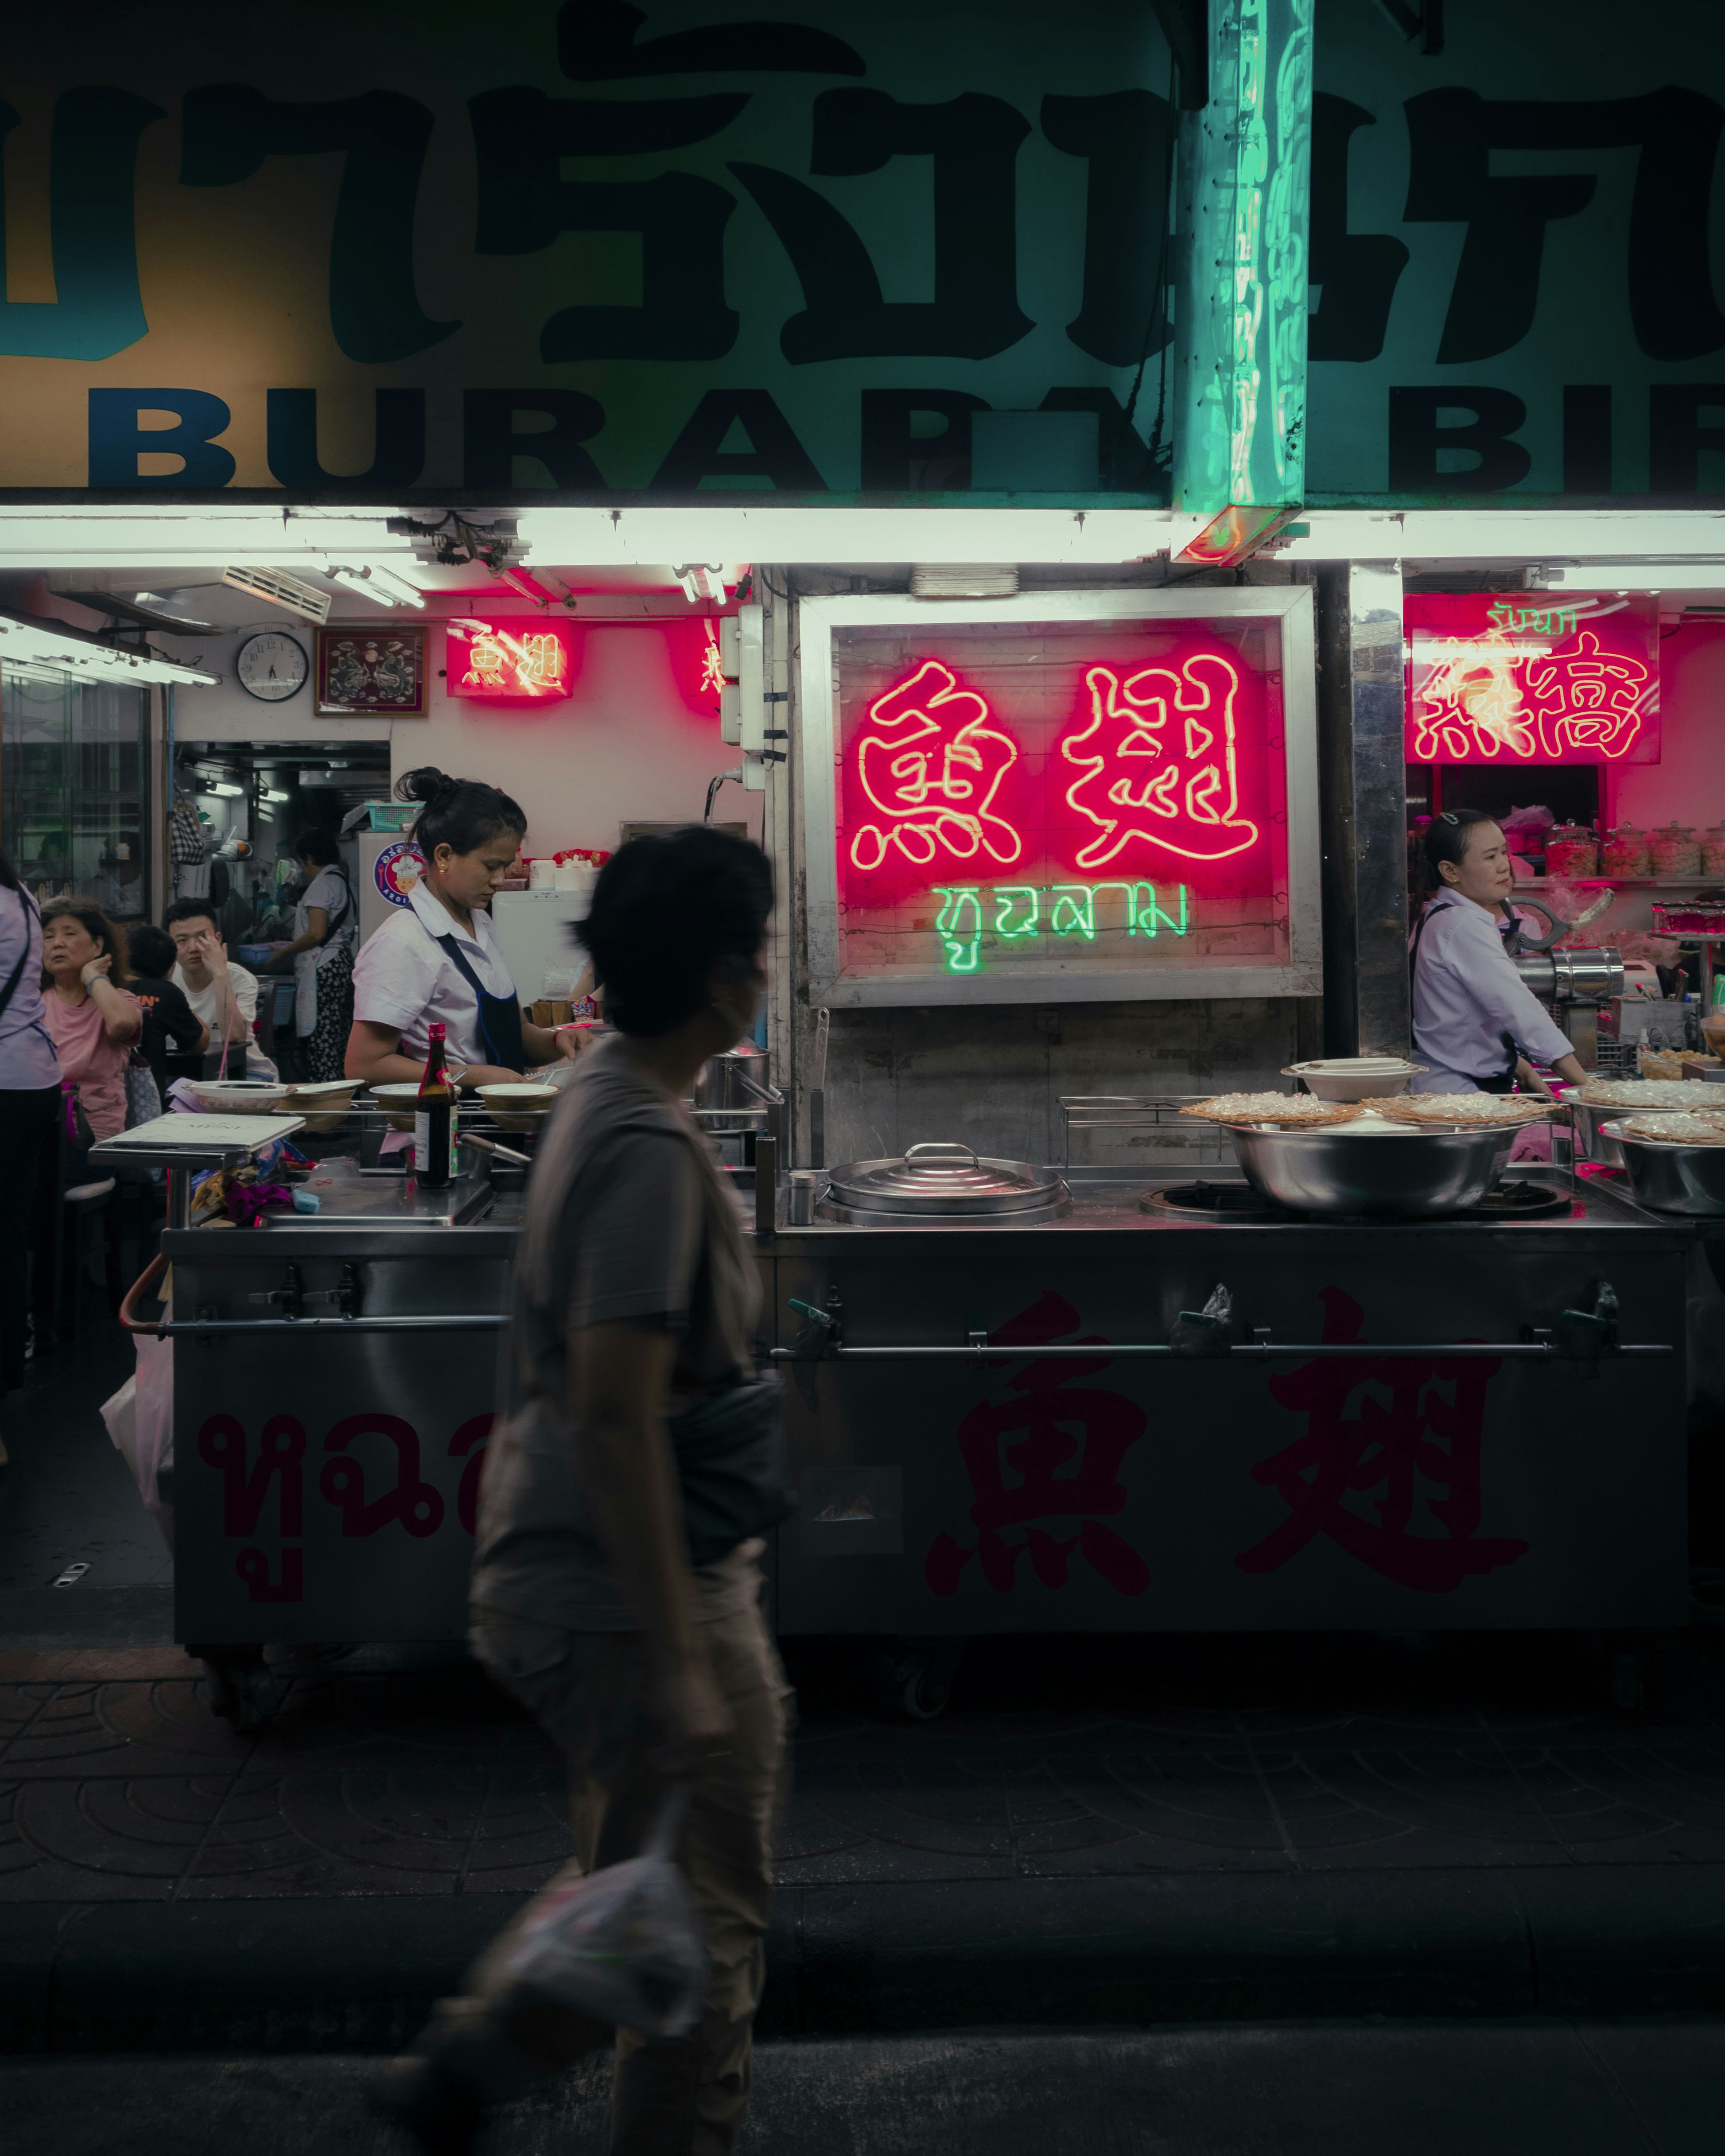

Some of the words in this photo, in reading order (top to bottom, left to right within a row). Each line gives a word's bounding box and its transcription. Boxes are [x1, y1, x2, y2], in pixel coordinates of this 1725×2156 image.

[1487, 602, 1577, 634] รังนก
[256, 645, 264, 653] 11
[267, 641, 276, 649] 12
[249, 652, 258, 661] 10
[288, 649, 294, 657] 2
[462, 630, 562, 687] 魚翅
[294, 660, 299, 668] 3
[850, 653, 1259, 869] 魚翅
[925, 1285, 1531, 1598] 魚翅
